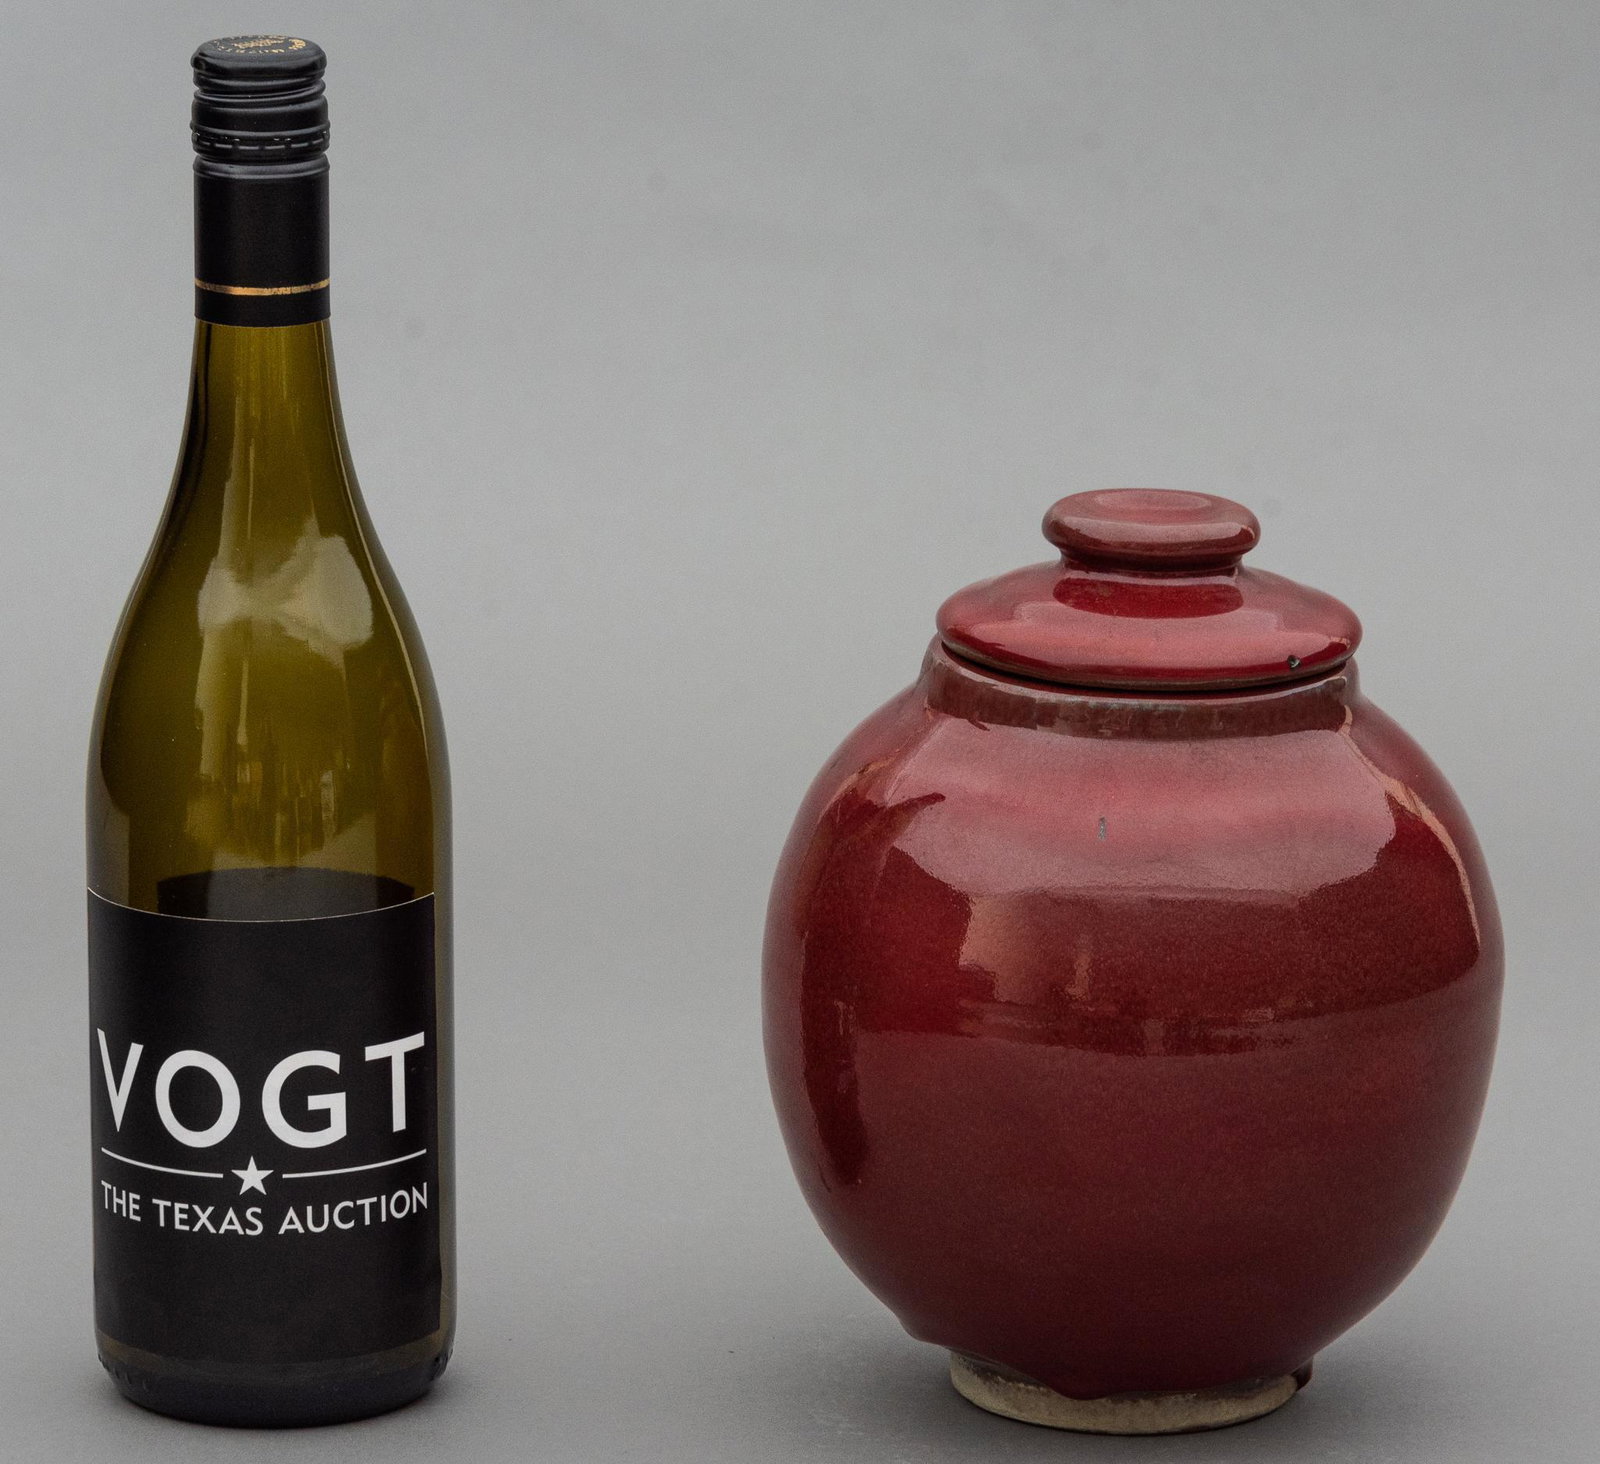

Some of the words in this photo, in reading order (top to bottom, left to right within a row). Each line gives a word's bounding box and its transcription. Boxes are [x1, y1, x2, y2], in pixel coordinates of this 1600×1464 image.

[97, 1028, 425, 1148] VOGT
[101, 1180, 141, 1221] THE
[152, 1199, 264, 1235] TEXAS
[278, 1182, 428, 1235] AUCTION
